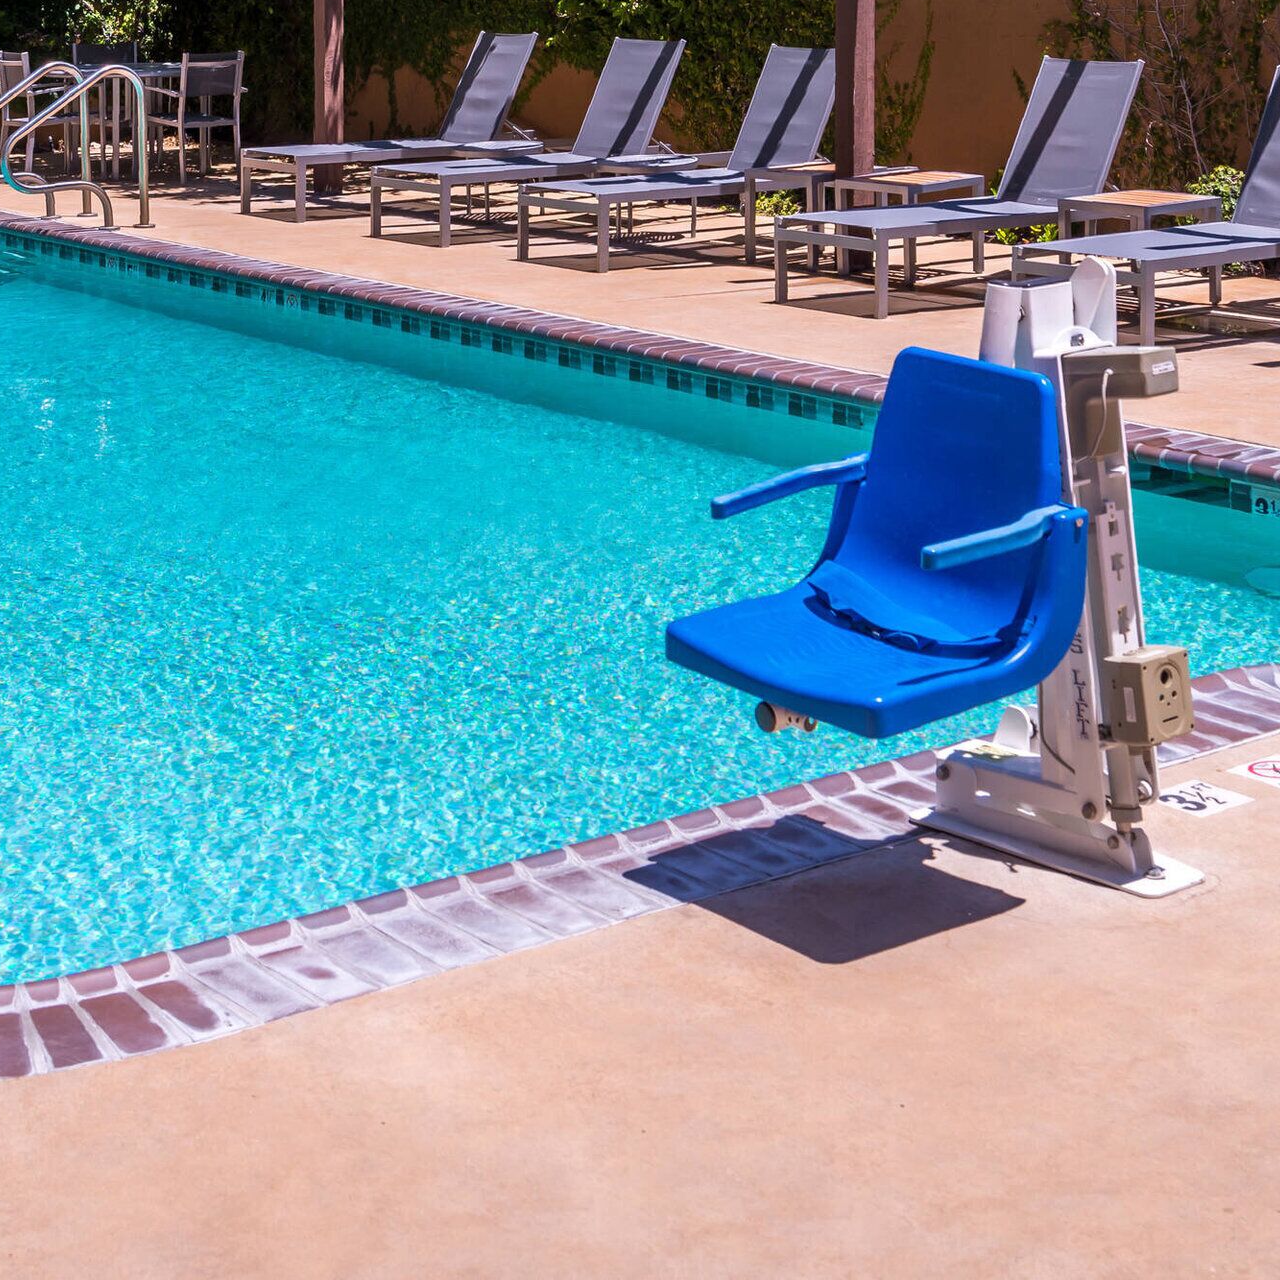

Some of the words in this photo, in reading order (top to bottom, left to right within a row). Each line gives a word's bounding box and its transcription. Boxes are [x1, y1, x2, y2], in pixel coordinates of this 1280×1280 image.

[1072, 669, 1090, 739] LIFT
[1159, 794, 1207, 811] 3
[1191, 782, 1213, 792] FT
